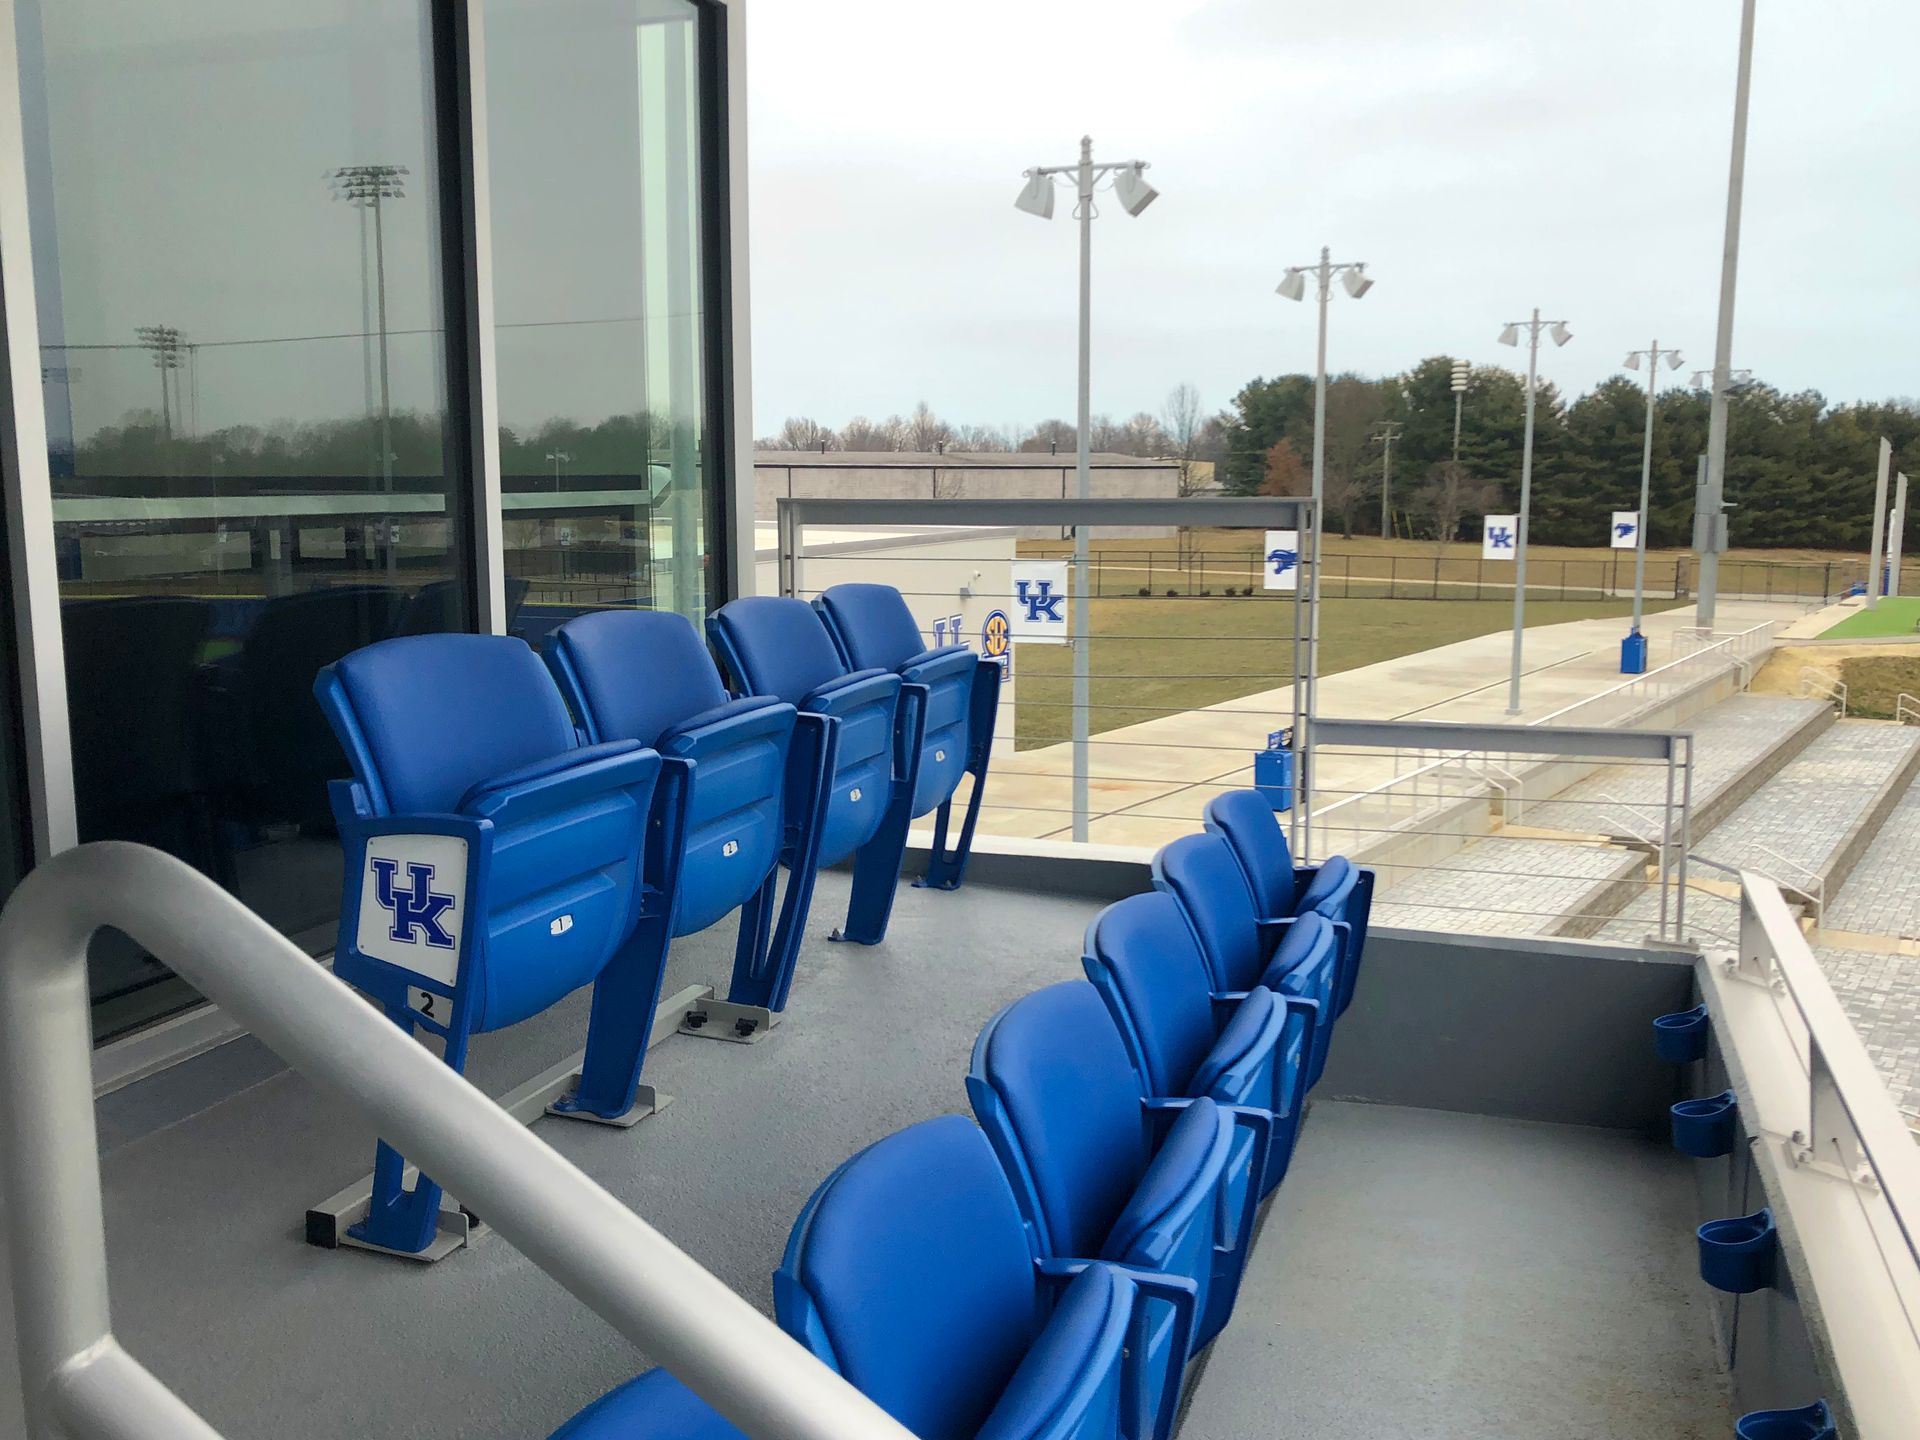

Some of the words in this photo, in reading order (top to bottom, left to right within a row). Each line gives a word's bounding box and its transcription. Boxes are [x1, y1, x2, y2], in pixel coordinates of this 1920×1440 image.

[1488, 527, 1513, 548] UK
[1015, 580, 1064, 623] UK
[371, 857, 455, 950] UK
[420, 991, 435, 1019] 2
